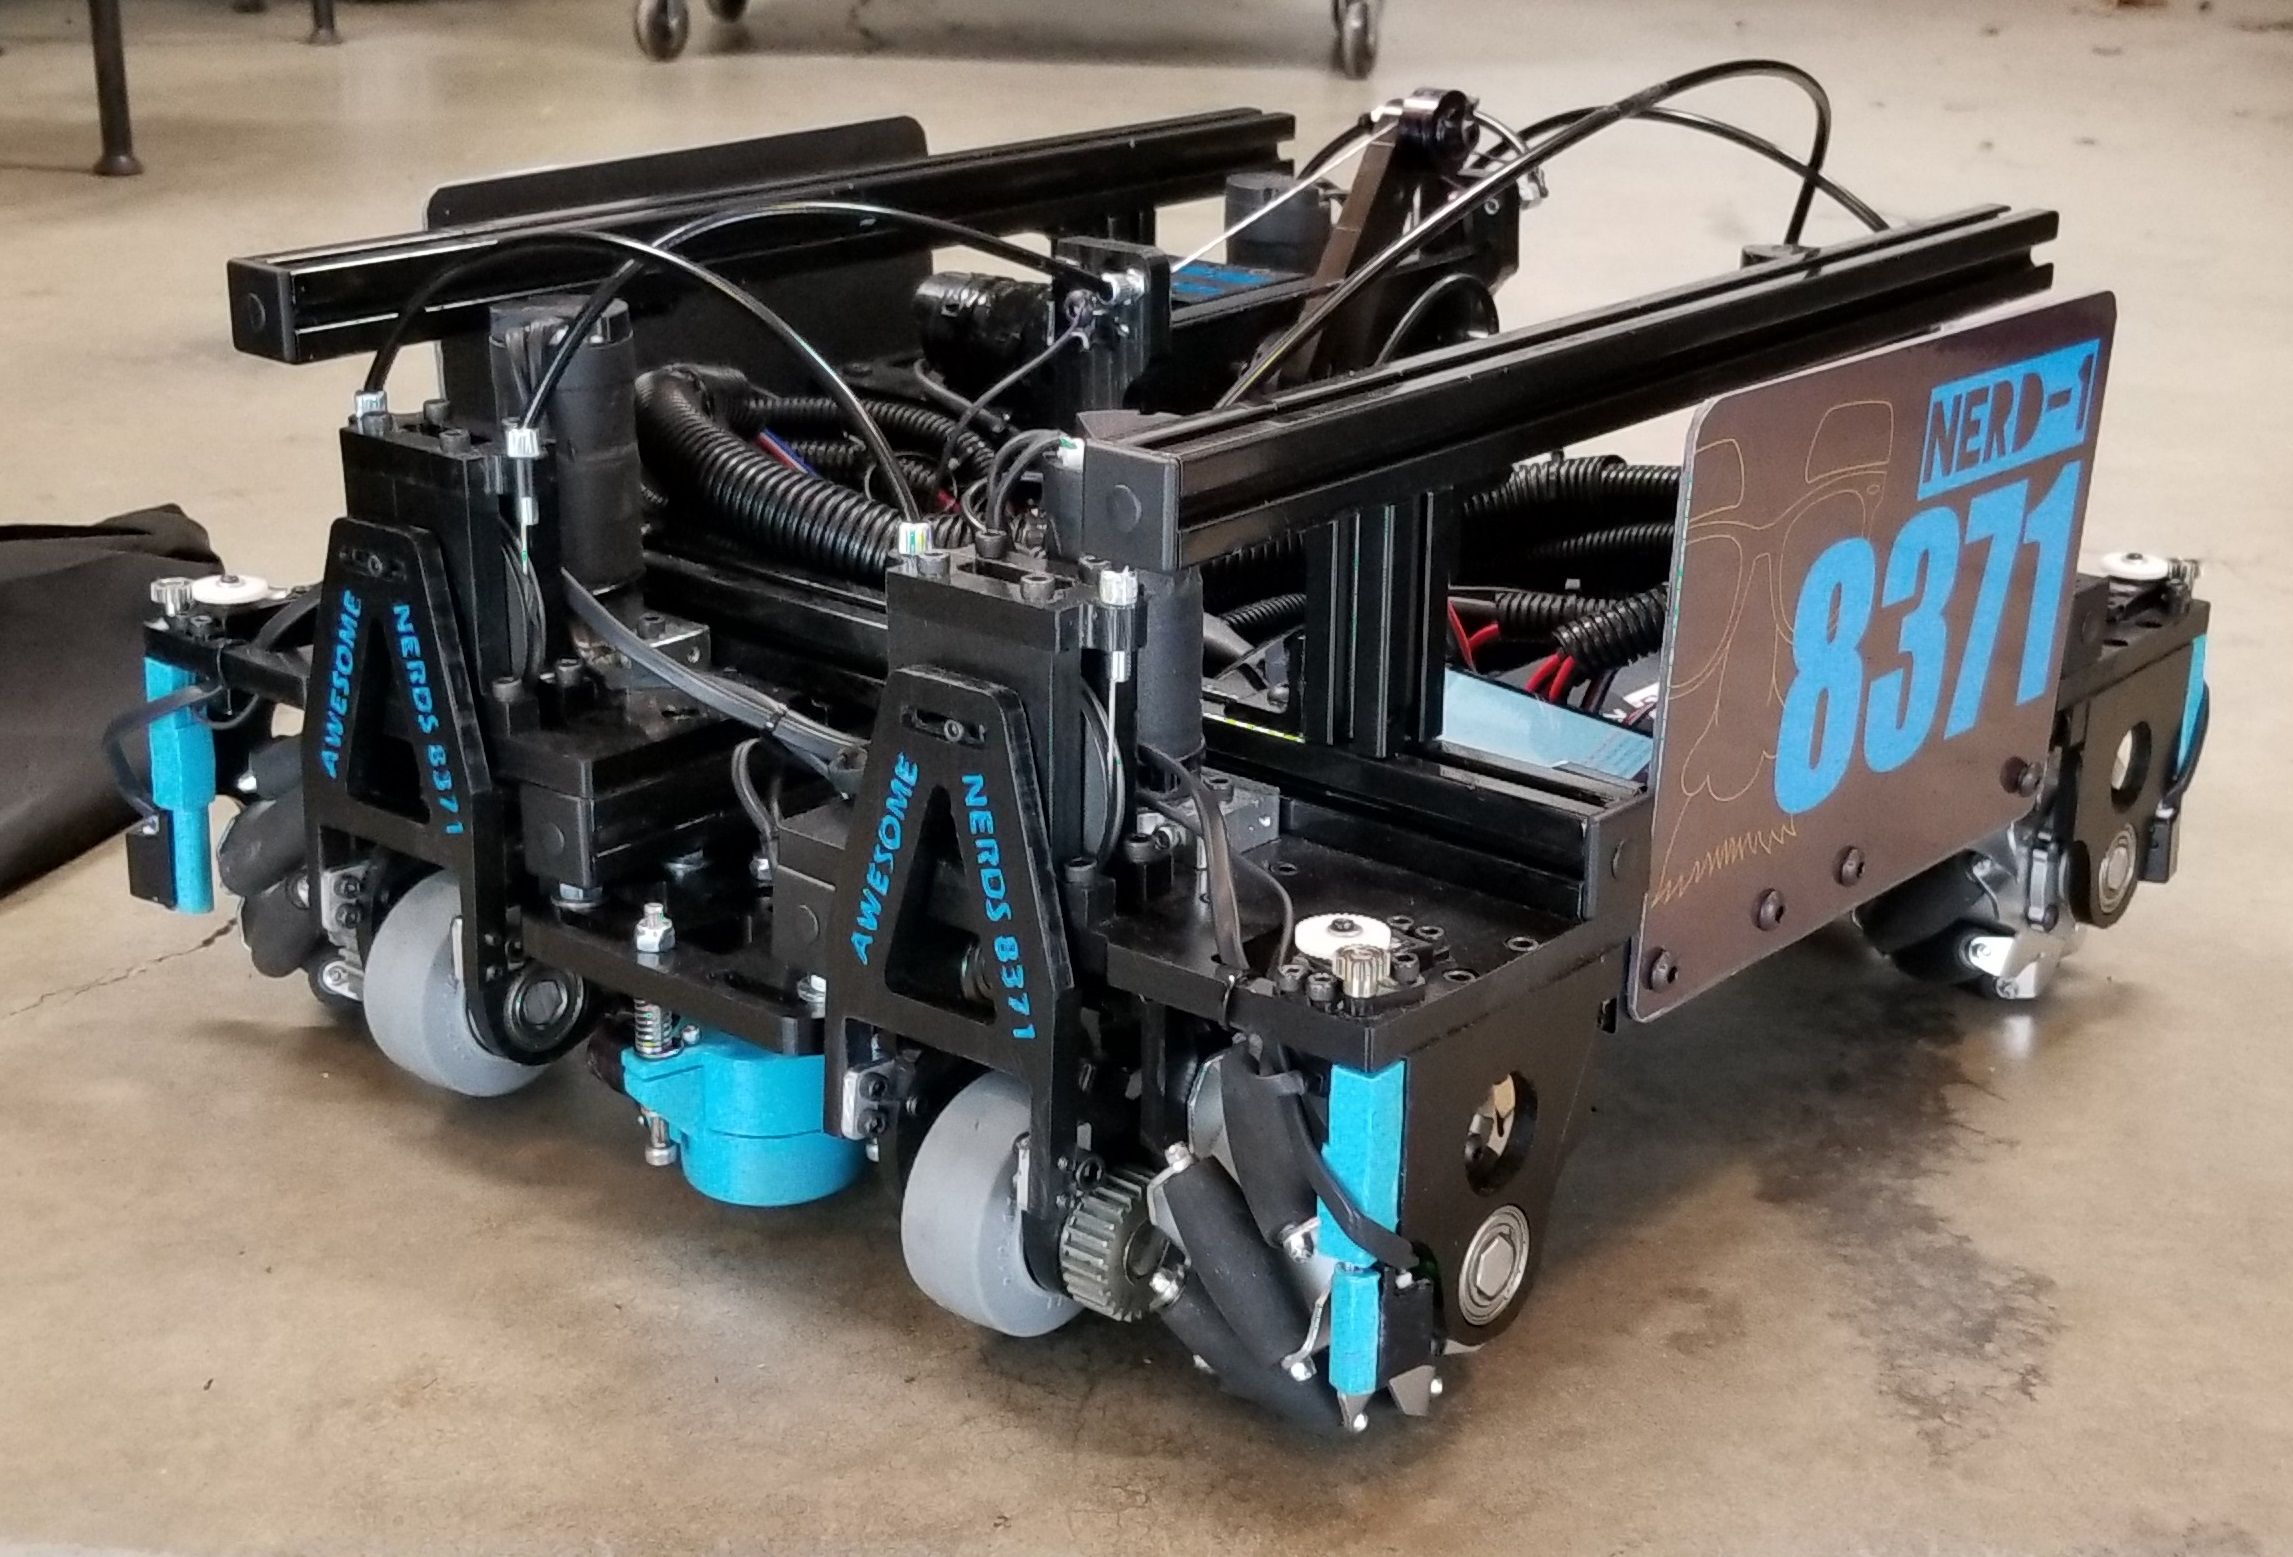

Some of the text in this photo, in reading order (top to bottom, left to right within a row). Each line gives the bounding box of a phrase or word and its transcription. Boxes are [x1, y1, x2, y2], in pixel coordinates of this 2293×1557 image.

[1921, 352, 2096, 485] NERD-1
[320, 589, 361, 779] AWESOME
[393, 603, 464, 835] NERDS 8371
[1774, 459, 2081, 813] 8371
[850, 752, 918, 967] AWESOME
[961, 773, 1036, 1040] NERDS 8371
